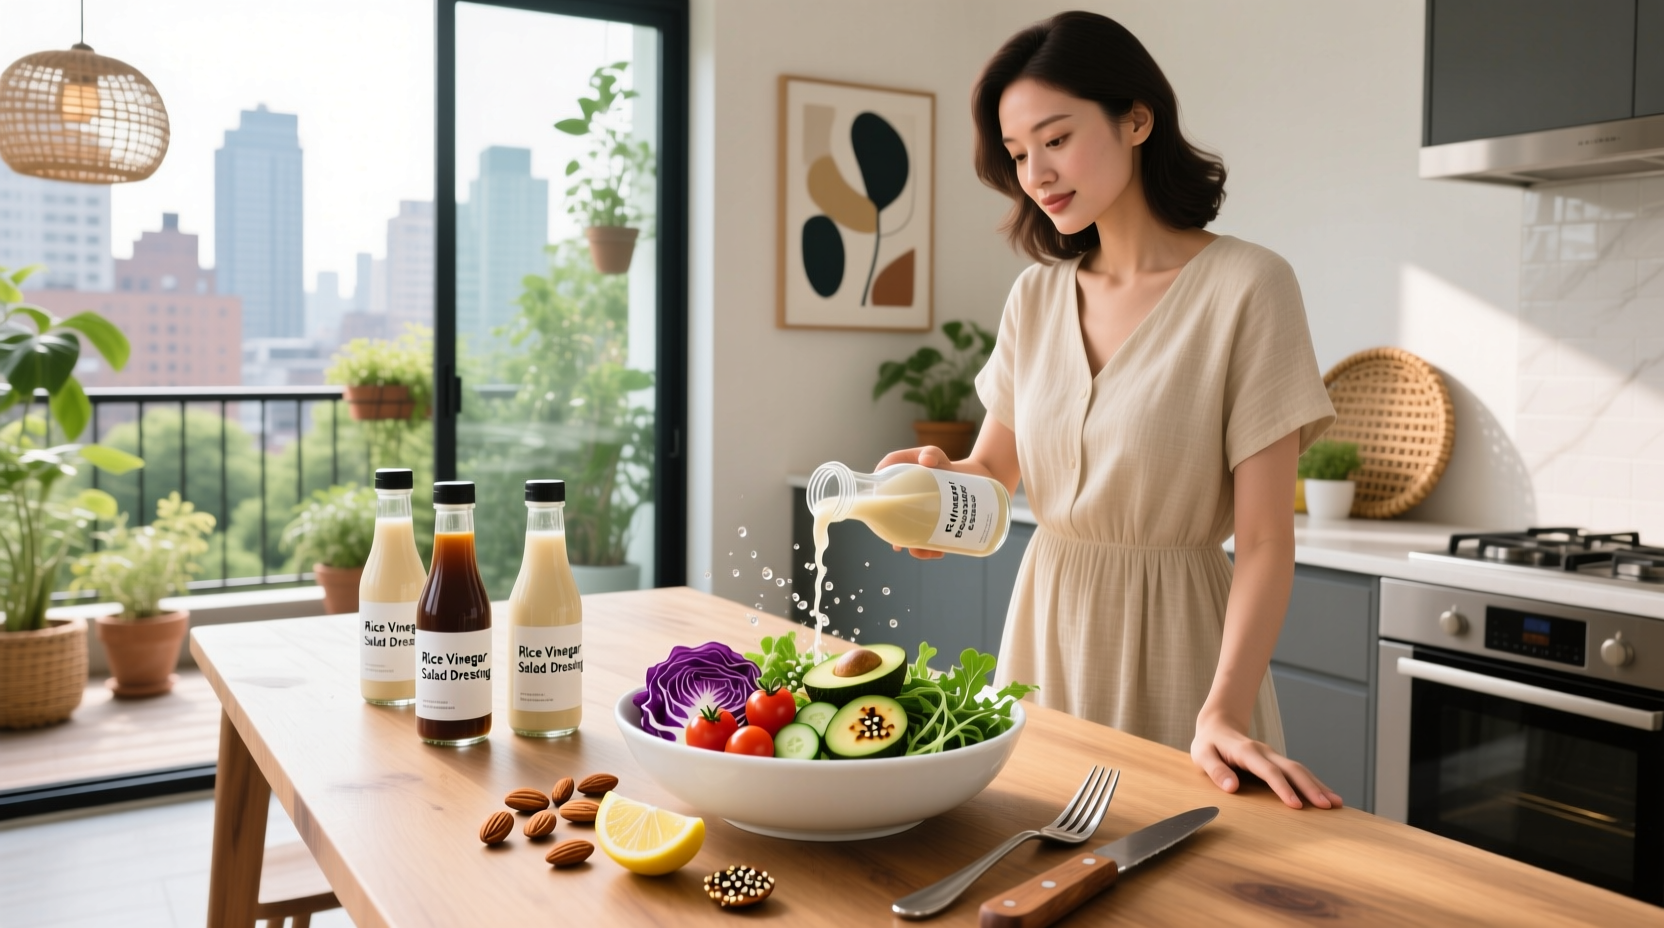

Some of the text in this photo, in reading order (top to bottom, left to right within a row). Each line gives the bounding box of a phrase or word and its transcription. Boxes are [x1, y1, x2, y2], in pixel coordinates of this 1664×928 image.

[388, 621, 415, 635] Vineg
[519, 645, 542, 658] Rice
[422, 651, 488, 667] Rice Vinegar
[421, 667, 447, 680] Salad
[518, 661, 547, 673] Salad
